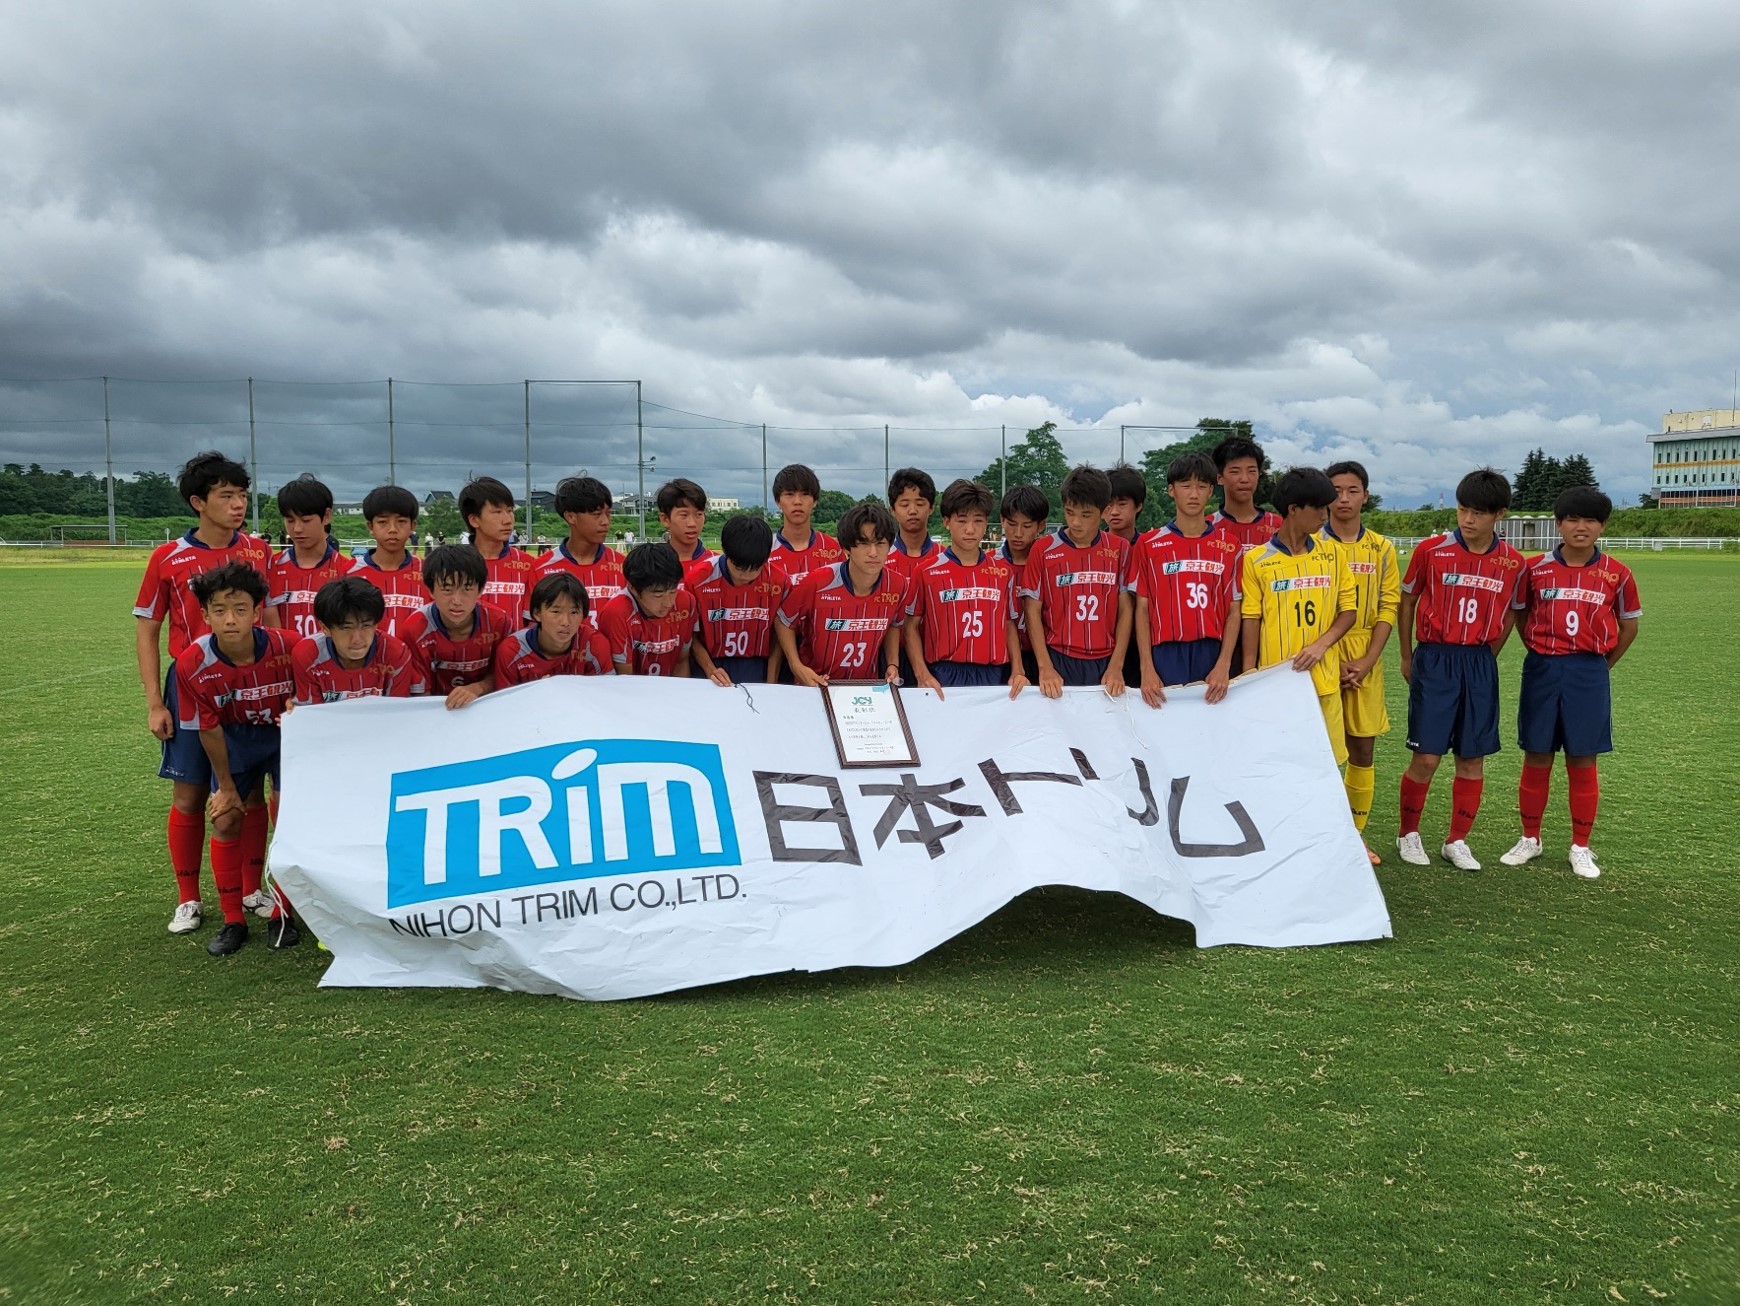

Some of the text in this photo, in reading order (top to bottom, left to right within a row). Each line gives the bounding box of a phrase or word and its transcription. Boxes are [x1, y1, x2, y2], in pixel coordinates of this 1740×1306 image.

[171, 555, 197, 566] ATHLETA
[1076, 595, 1099, 621] 32
[1186, 582, 1208, 609] 36
[1295, 600, 1316, 628] 16
[1458, 597, 1478, 624] 18
[1565, 610, 1580, 637] 9
[294, 614, 318, 638] 30
[849, 619, 888, 630] 京王観光
[961, 611, 983, 639] 25
[724, 630, 749, 657] 50
[839, 642, 867, 667] 23
[244, 708, 273, 725] 53
[388, 897, 502, 939] NIHON
[511, 886, 599, 925] TRIM
